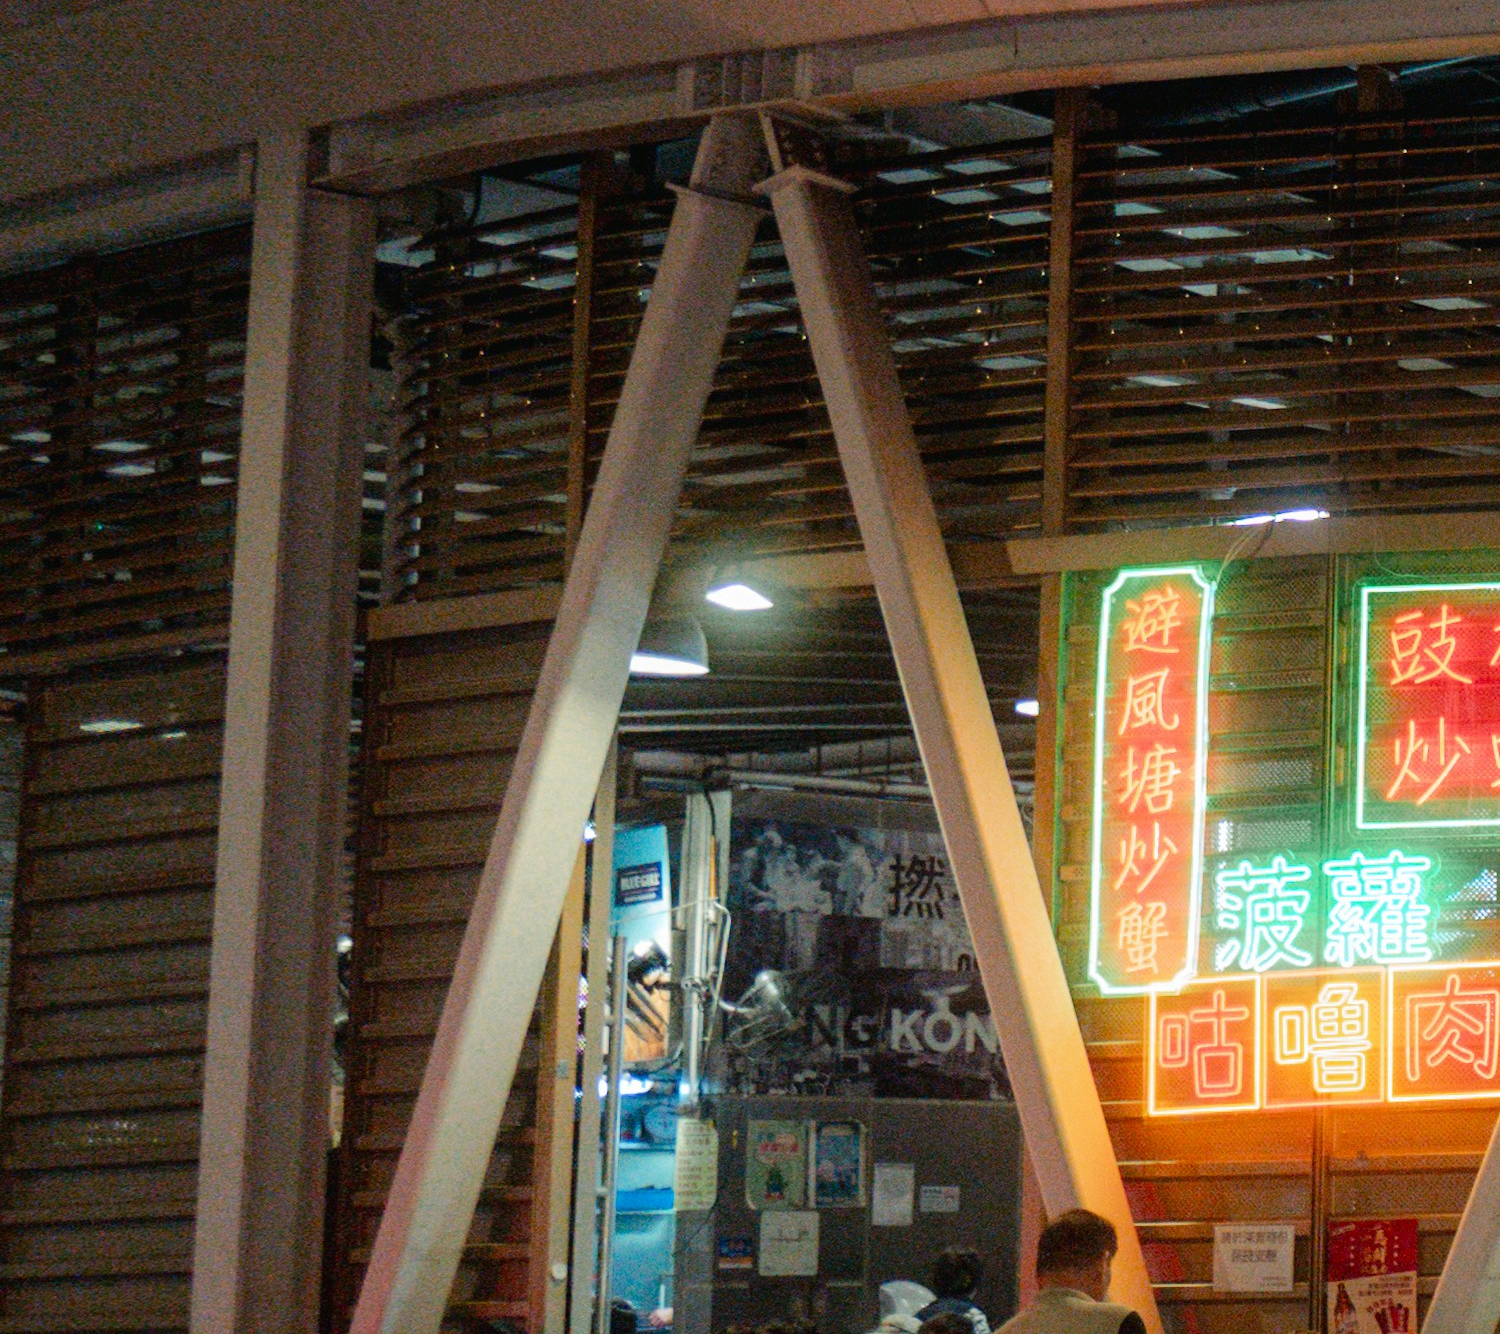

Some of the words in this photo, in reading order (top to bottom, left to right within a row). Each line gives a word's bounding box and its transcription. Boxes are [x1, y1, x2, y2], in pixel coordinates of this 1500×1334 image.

[1113, 586, 1182, 974] 避風塘炒蟹
[1215, 849, 1433, 972] 菠蘿
[1158, 975, 1500, 1099] 咕嚕肉
